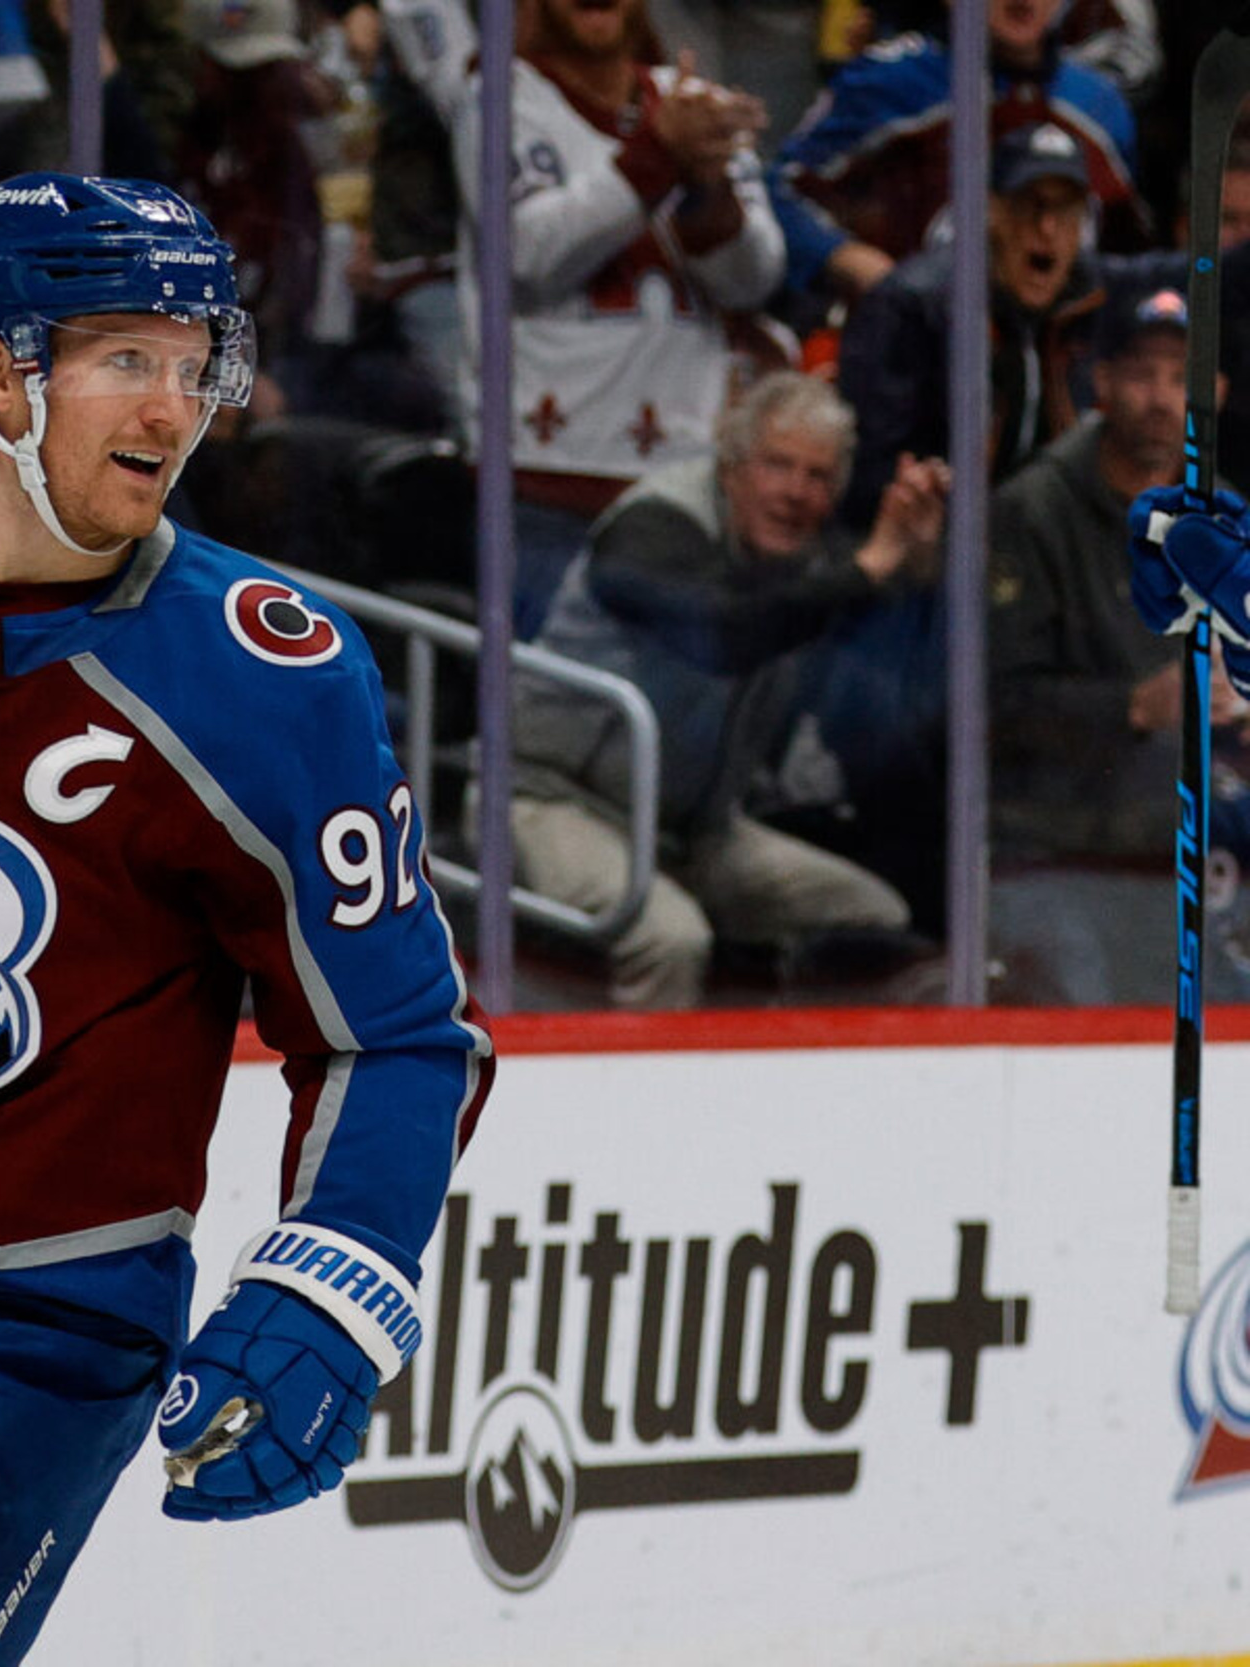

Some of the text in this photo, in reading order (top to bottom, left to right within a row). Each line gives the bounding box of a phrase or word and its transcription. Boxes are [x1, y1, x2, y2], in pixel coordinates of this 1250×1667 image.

[153, 250, 217, 266] BAUER
[23, 722, 135, 824] C
[318, 780, 418, 930] 92
[1175, 780, 1199, 1022] PULSE
